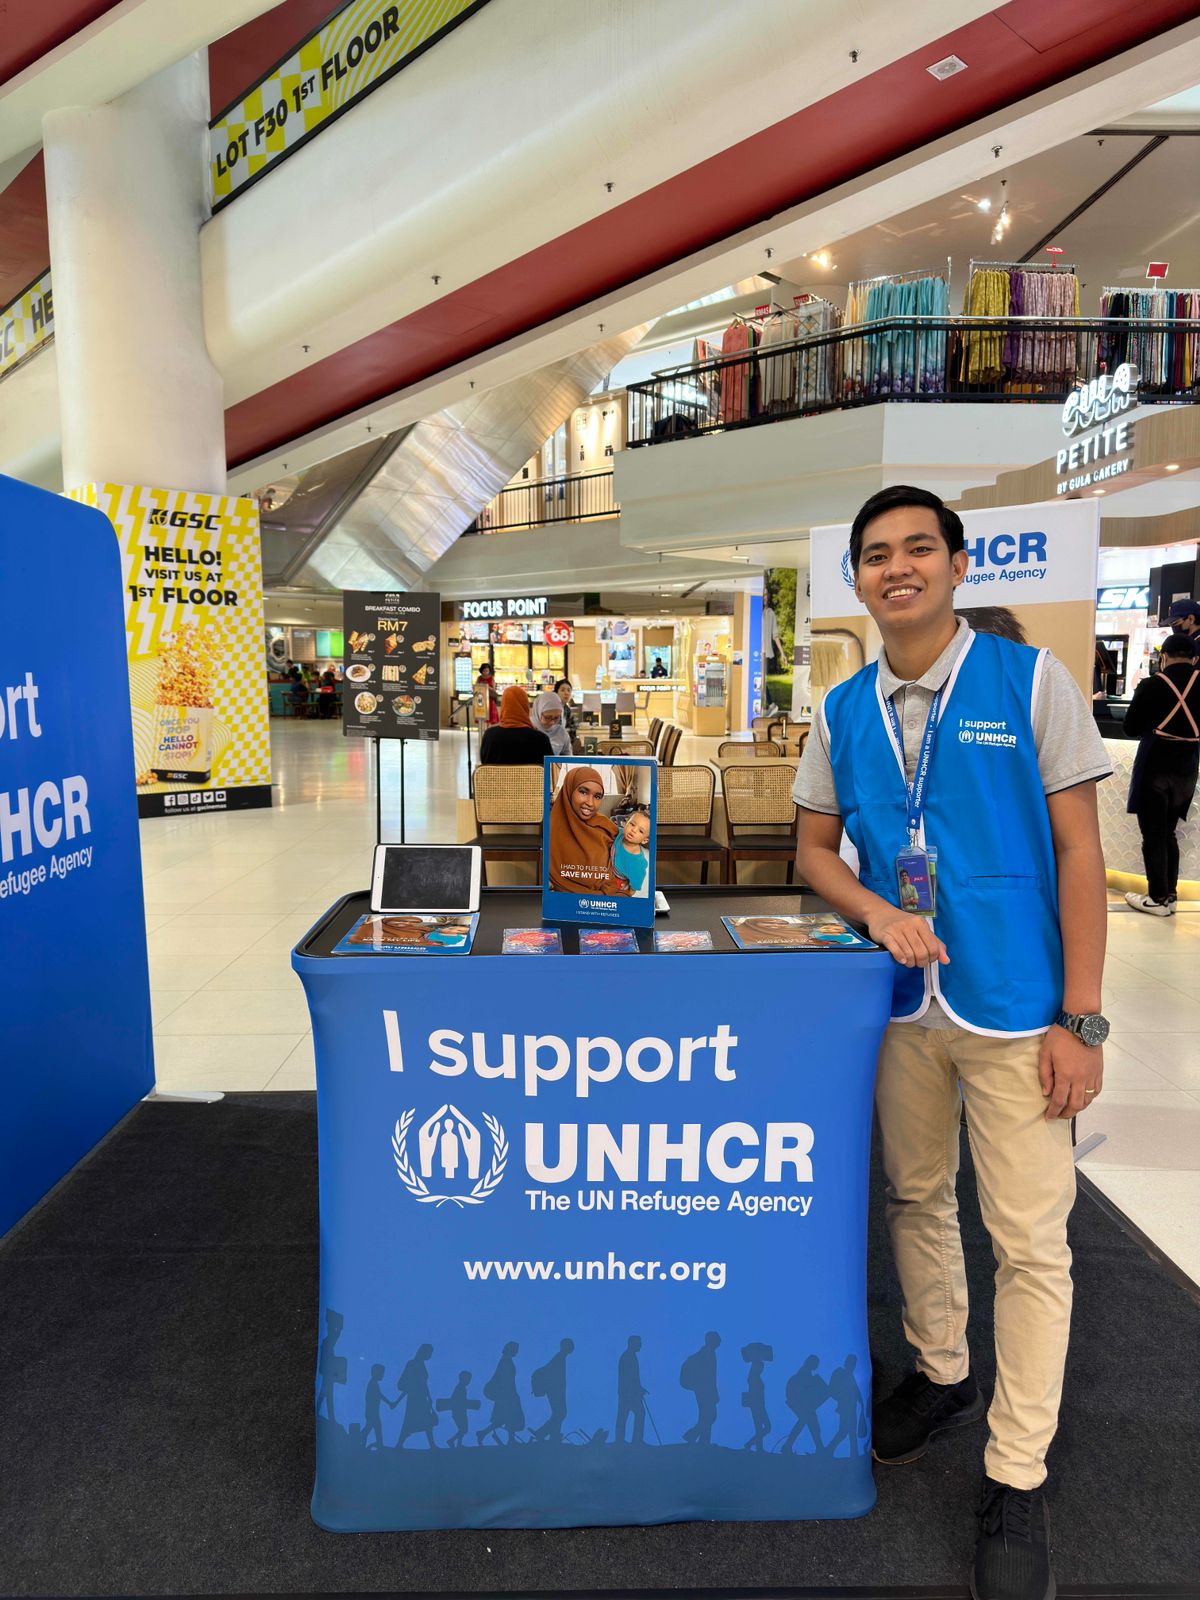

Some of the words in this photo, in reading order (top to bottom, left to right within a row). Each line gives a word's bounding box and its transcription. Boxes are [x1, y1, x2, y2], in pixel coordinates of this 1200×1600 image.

[216, 129, 249, 177] LOT
[254, 99, 288, 146] F30
[293, 75, 315, 113] 1ST
[321, 6, 400, 91] FLOOR
[1056, 422, 1128, 474] PETITE
[1057, 482, 1067, 495] BY
[1069, 473, 1091, 490] GULA
[1093, 459, 1129, 480] CAKERY
[169, 511, 221, 530] GSC
[144, 546, 222, 566] HELLO!
[145, 568, 180, 580] VISIT
[184, 571, 202, 581] US
[206, 573, 223, 582] AT
[962, 571, 995, 585] ugee
[999, 568, 1047, 581] Agency
[129, 585, 155, 602] 1ST
[162, 587, 238, 606] FLOOR
[463, 600, 503, 618] FOCUS
[507, 597, 547, 616] POINT
[377, 620, 408, 632] RM7
[551, 629, 569, 641] 68
[0, 672, 42, 740] rt
[168, 726, 190, 734] POP
[960, 719, 963, 727] I
[965, 720, 1006, 730] support
[159, 742, 198, 751] CANNOT
[163, 734, 194, 743] HELLO
[925, 734, 932, 745] am
[976, 732, 1017, 744] UNHCR
[587, 744, 594, 753] 2
[920, 750, 930, 776] UNHCR
[914, 777, 924, 808] supporter
[50, 846, 93, 880] Agency
[590, 900, 617, 909] UNHCR
[383, 1009, 404, 1073] I
[428, 1024, 738, 1098] support
[525, 1121, 815, 1183] UNHCR
[525, 1190, 572, 1211] The
[577, 1190, 613, 1211] UN
[621, 1190, 720, 1216] Refugee
[727, 1191, 813, 1216] Agency
[463, 1252, 727, 1290] www.unhcr.org
